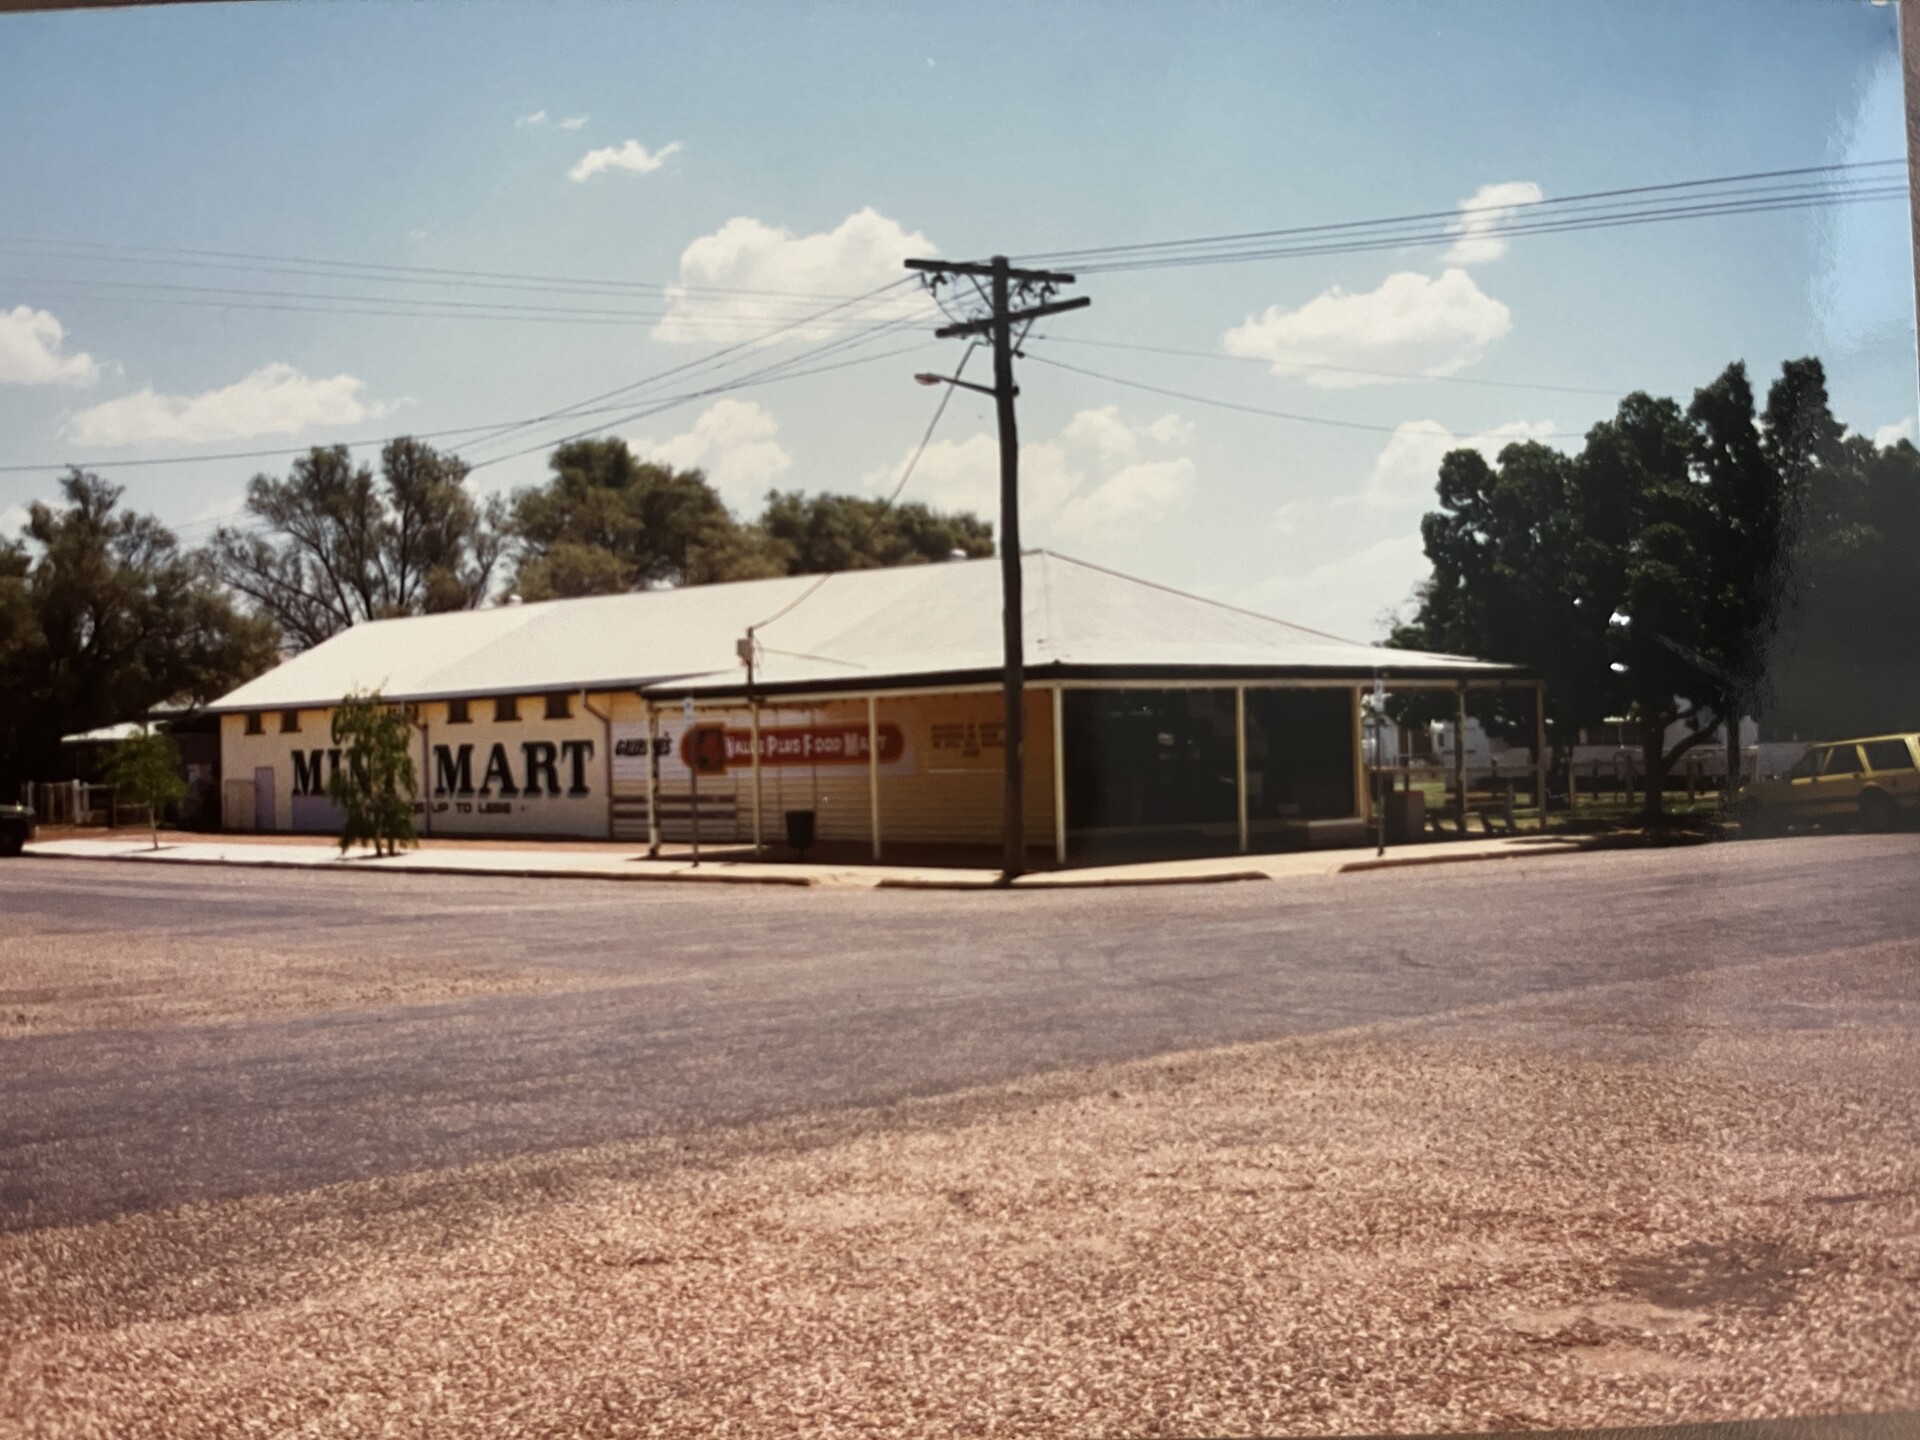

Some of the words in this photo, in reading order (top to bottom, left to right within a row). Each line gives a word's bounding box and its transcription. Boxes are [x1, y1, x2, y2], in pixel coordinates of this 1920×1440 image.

[725, 736, 765, 758] VALE
[766, 735, 801, 757] PLUS
[803, 734, 841, 757] FOOD
[844, 732, 887, 757] MAT
[291, 747, 397, 797] MIN
[433, 739, 595, 796] MART
[456, 802, 472, 813] TO
